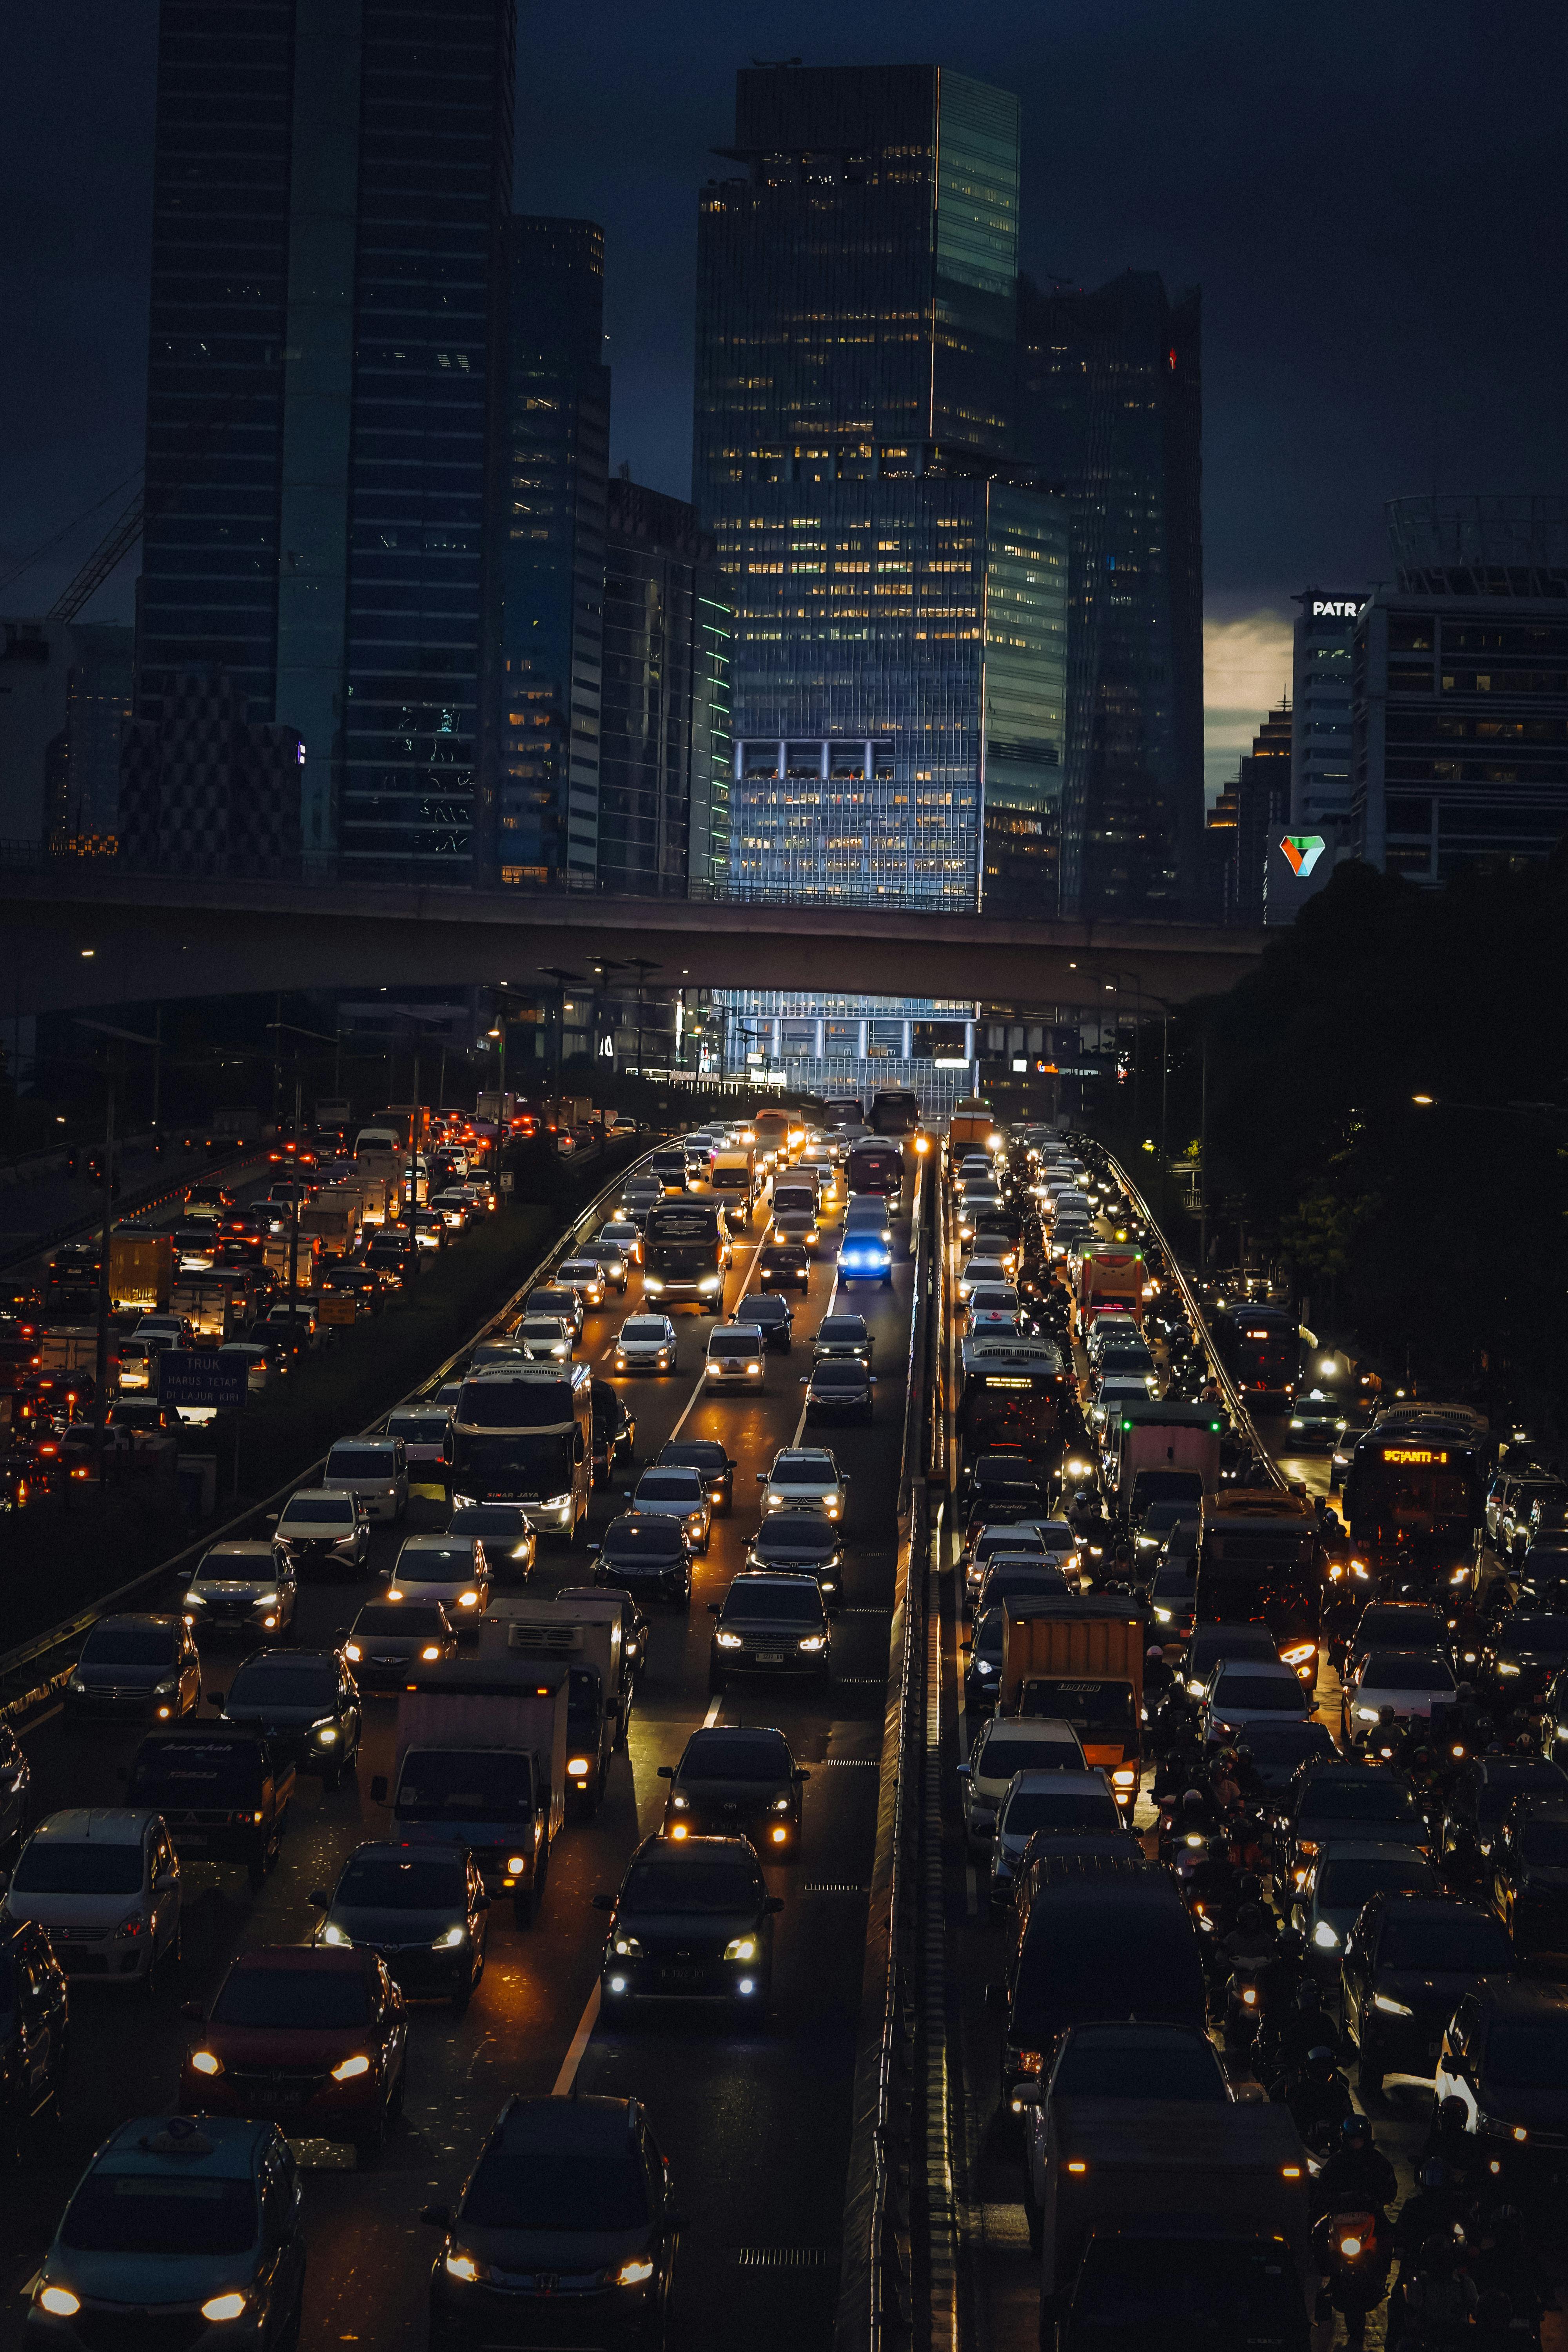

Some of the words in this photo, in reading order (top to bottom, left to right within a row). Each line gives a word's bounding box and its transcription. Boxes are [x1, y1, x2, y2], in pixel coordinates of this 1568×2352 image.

[187, 1358, 220, 1370] TRUK
[169, 1376, 201, 1385] HARUS
[209, 1377, 237, 1387] TETAP
[166, 1390, 175, 1399] DI
[181, 1391, 213, 1401] LAJUR
[220, 1393, 238, 1401] KIRI
